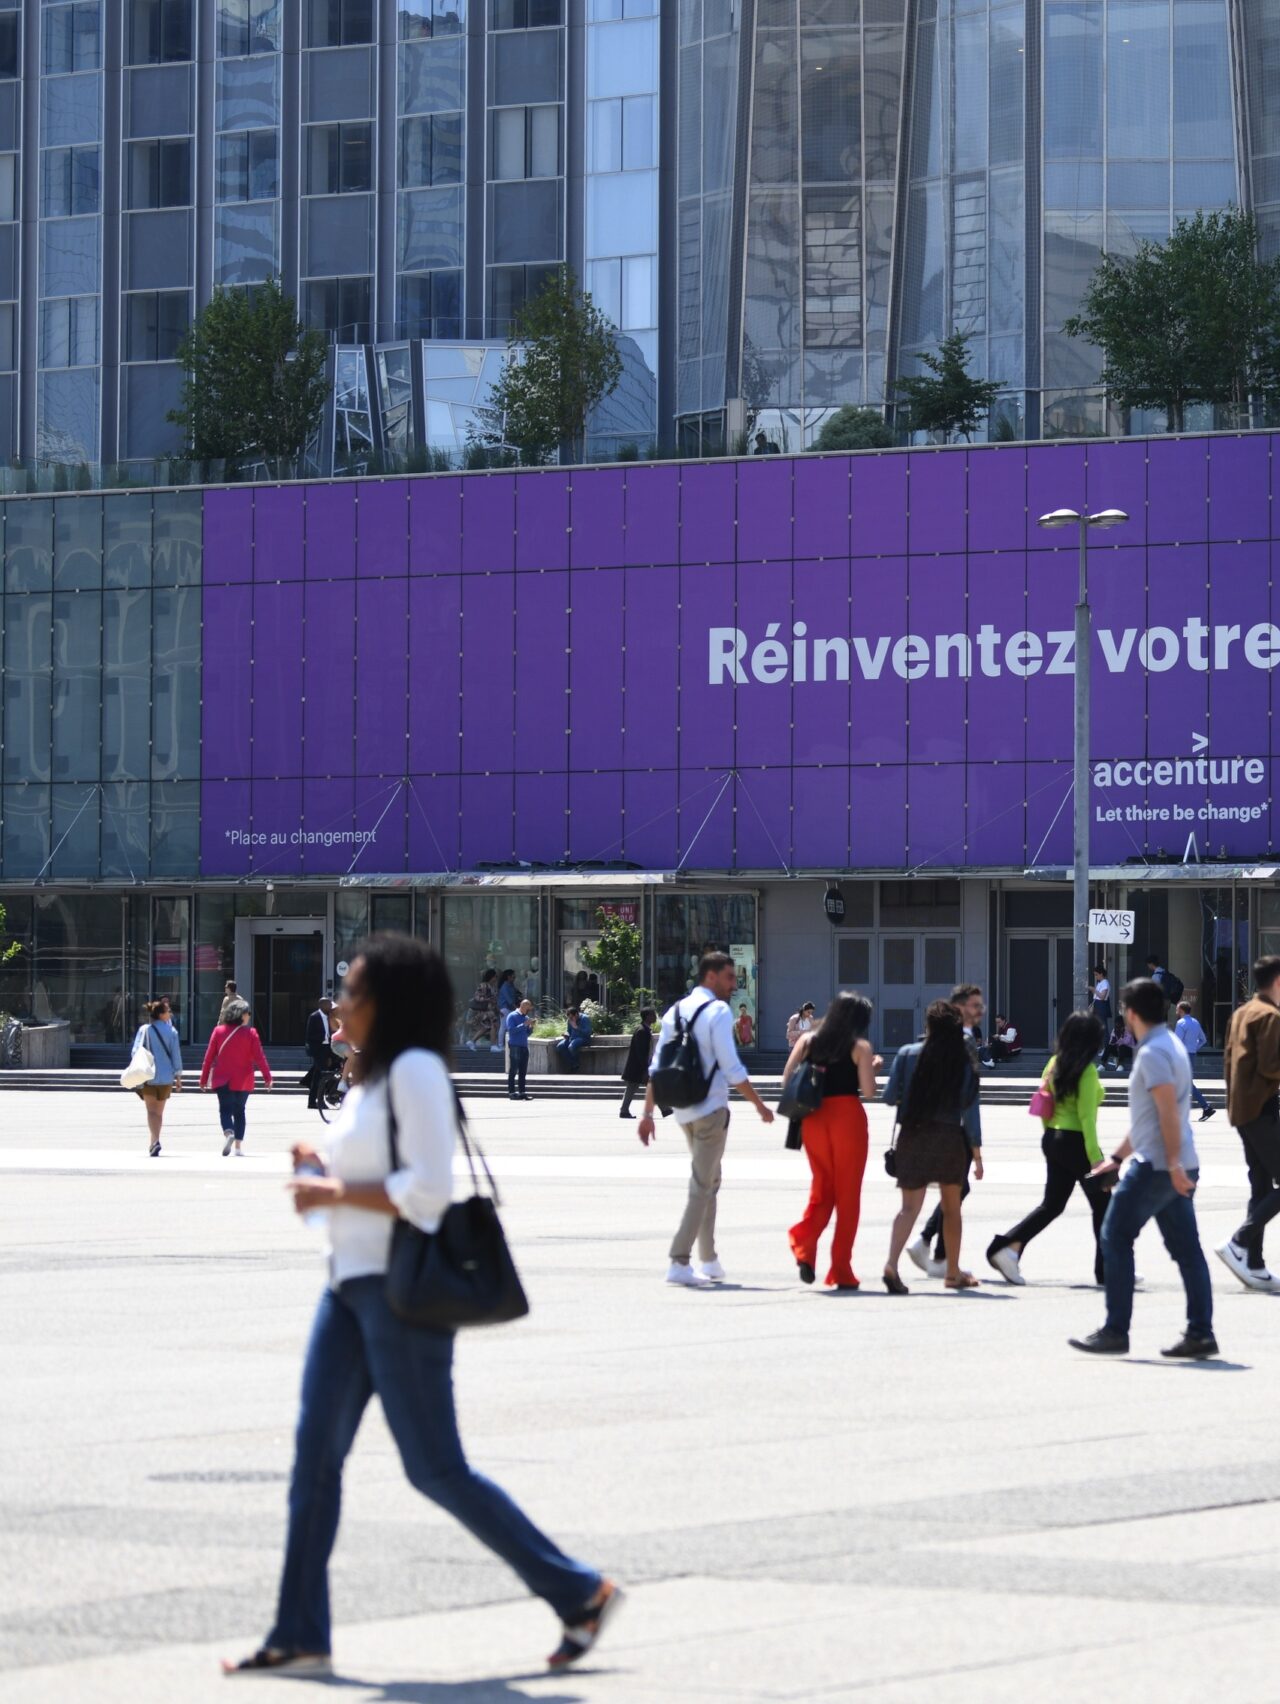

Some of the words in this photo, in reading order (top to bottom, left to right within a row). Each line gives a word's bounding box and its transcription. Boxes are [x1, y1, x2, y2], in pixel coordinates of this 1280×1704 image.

[708, 621, 1075, 685] Réinventez
[1093, 753, 1265, 787] accenture
[1096, 806, 1122, 822] Let
[1126, 804, 1170, 821] there
[1173, 804, 1195, 820] be
[270, 833, 287, 844] au
[290, 829, 376, 847] changement
[1091, 913, 1132, 927] TAXIS
